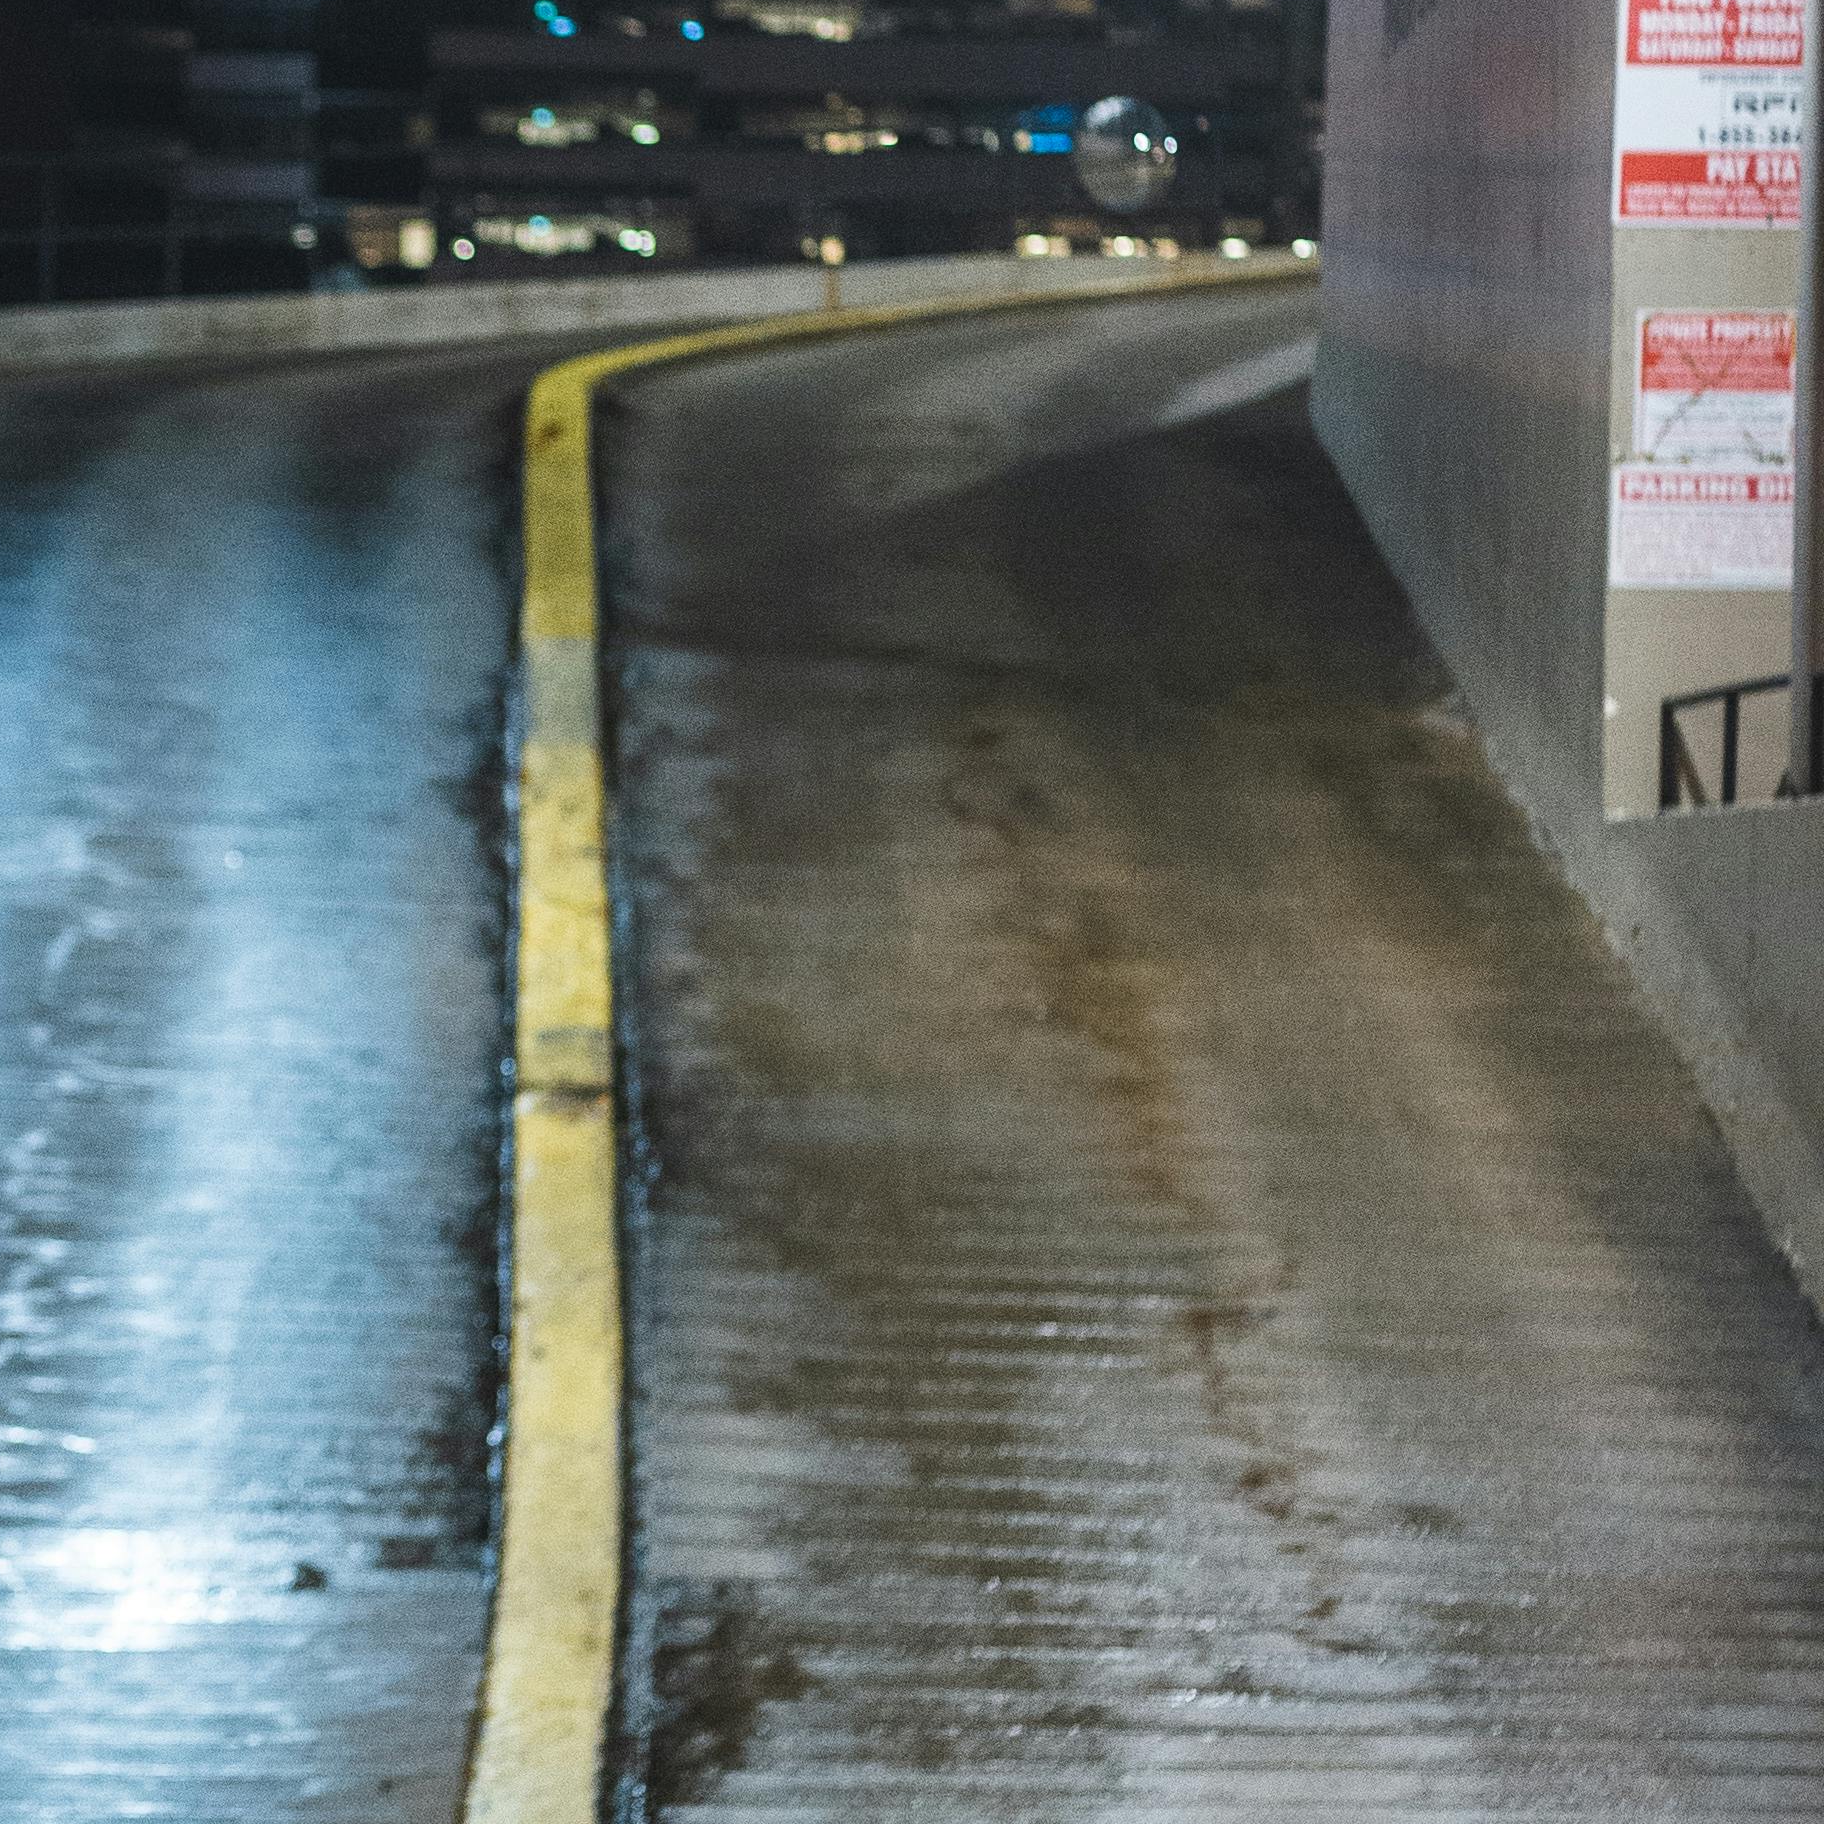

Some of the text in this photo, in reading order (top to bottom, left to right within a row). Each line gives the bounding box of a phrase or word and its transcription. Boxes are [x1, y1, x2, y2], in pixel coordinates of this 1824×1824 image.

[1639, 9, 1724, 33] MONDAY
[1739, 11, 1802, 34] FRIDA
[1707, 155, 1748, 184] PAY
[1623, 476, 1747, 500] PARKING
